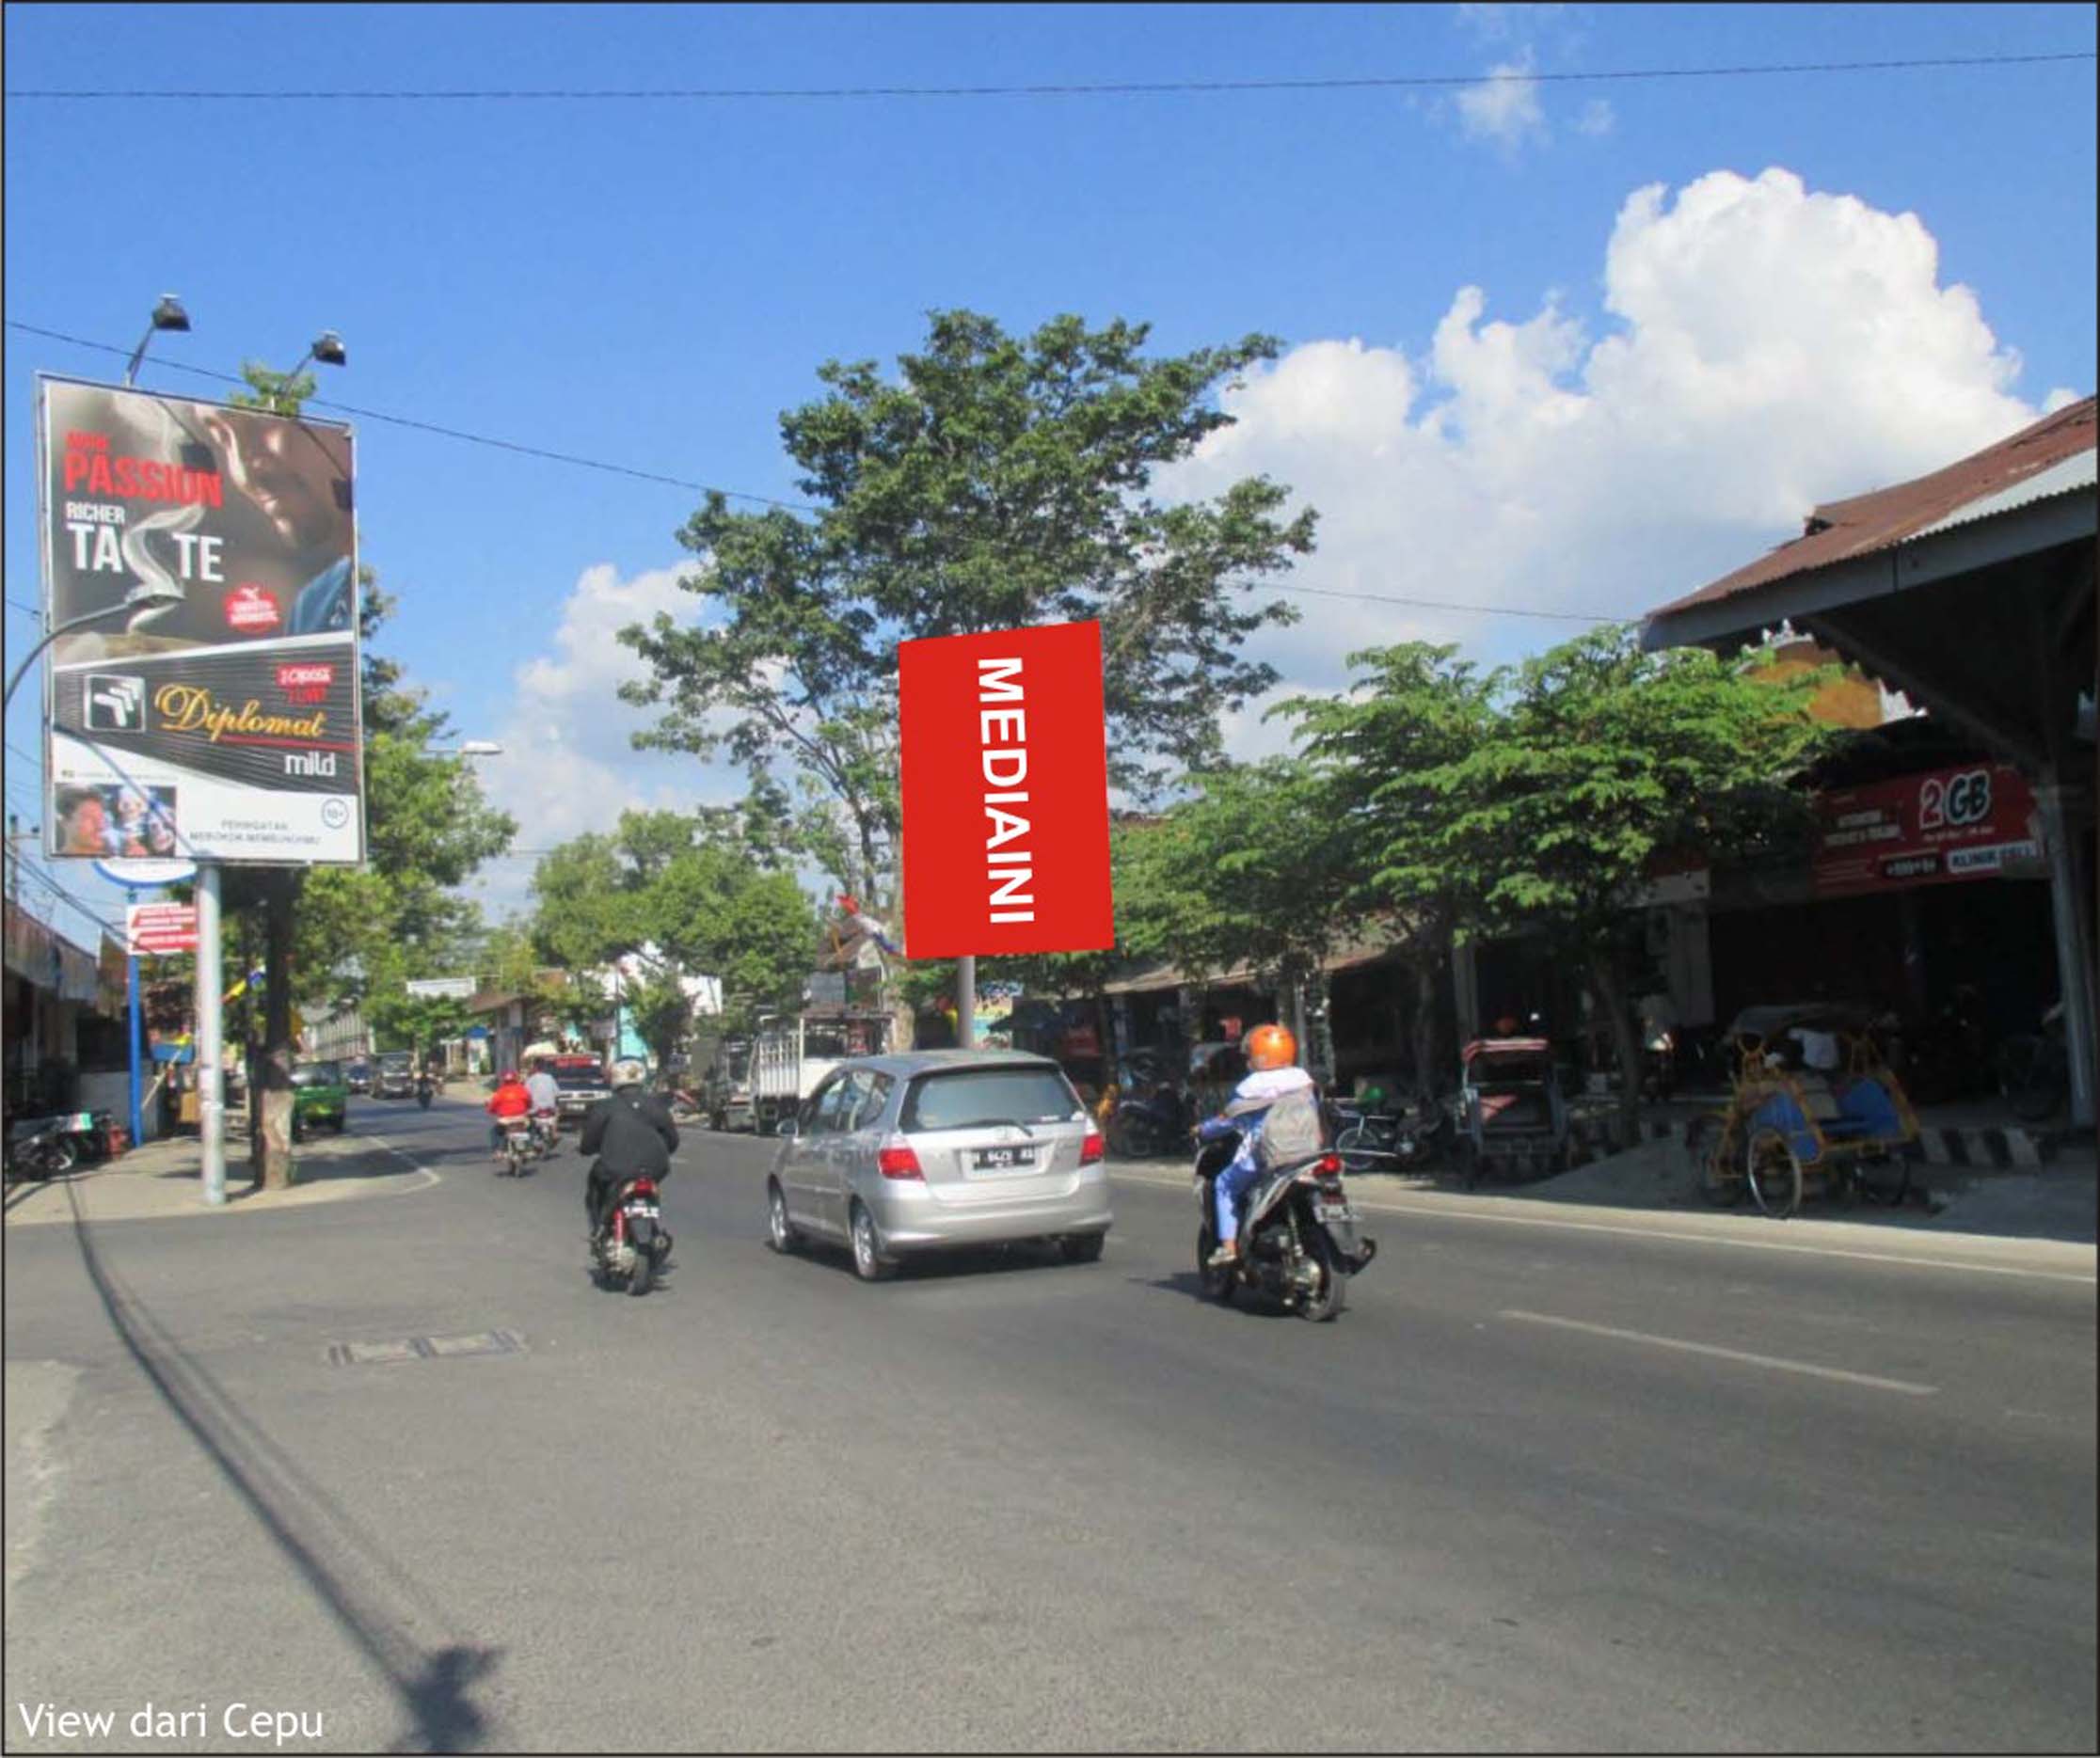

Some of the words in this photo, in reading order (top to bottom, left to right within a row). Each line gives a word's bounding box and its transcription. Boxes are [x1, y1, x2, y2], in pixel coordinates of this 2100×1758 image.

[64, 450, 224, 508] PASSION
[66, 501, 126, 525] RICHER
[154, 683, 326, 742] Diplomat
[285, 752, 336, 777] mild
